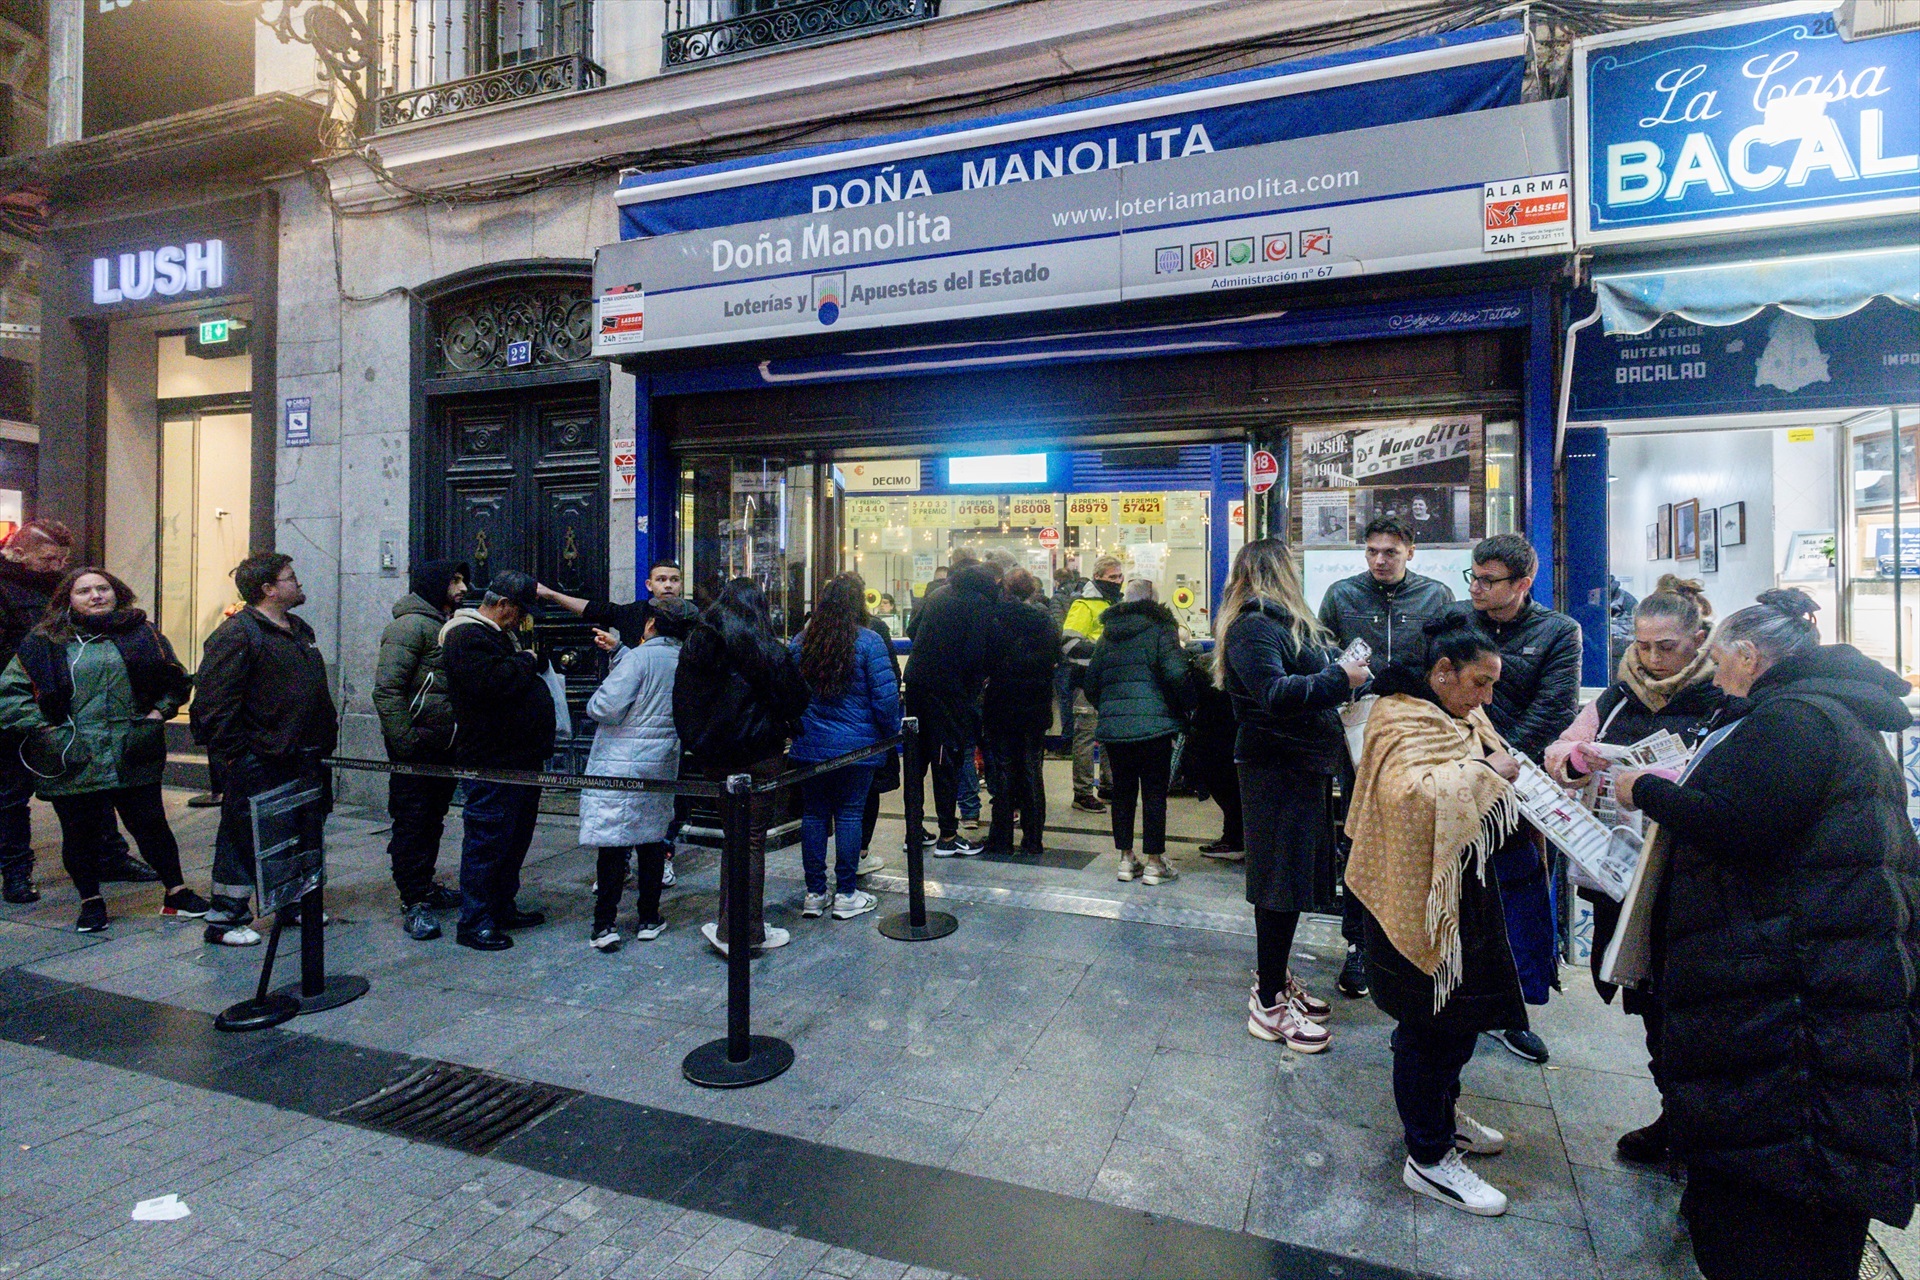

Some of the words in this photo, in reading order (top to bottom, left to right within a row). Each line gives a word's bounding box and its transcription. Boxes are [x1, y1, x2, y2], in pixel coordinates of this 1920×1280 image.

[1639, 64, 1722, 128] La
[1741, 51, 1890, 113] Casa
[812, 165, 933, 213] DOÑA
[963, 123, 1214, 190] MANOLITA
[1486, 178, 1568, 198] ALARMA
[1052, 169, 1359, 227] www.loteriamanolita.com
[1525, 202, 1566, 214] LASSER
[712, 232, 792, 272] Doña
[802, 210, 950, 260] Manolita
[1491, 233, 1515, 246] 24h
[93, 239, 222, 304] LUSH
[1211, 271, 1298, 289] Administración
[1317, 266, 1333, 277] 67
[724, 294, 792, 318] Loterías
[798, 294, 808, 313] y
[851, 277, 938, 305] Apuestas
[944, 270, 973, 291] del
[979, 263, 1050, 288] Estado
[621, 315, 642, 324] LASSER
[603, 334, 616, 343] 24h
[511, 345, 526, 361] 22
[1621, 344, 1701, 359] AUTENTICO
[1616, 362, 1707, 383] BACALAO
[1309, 440, 1349, 455] DESDE
[872, 477, 911, 486] DECIMO
[851, 505, 886, 513] 13440
[912, 500, 948, 508] 57033
[958, 505, 996, 515] 01568
[1014, 504, 1051, 514] 88008
[1070, 503, 1109, 513] 88979
[1123, 503, 1160, 513] 57421
[538, 774, 644, 790] WWW.LOTERIAMANOLITA.COM
